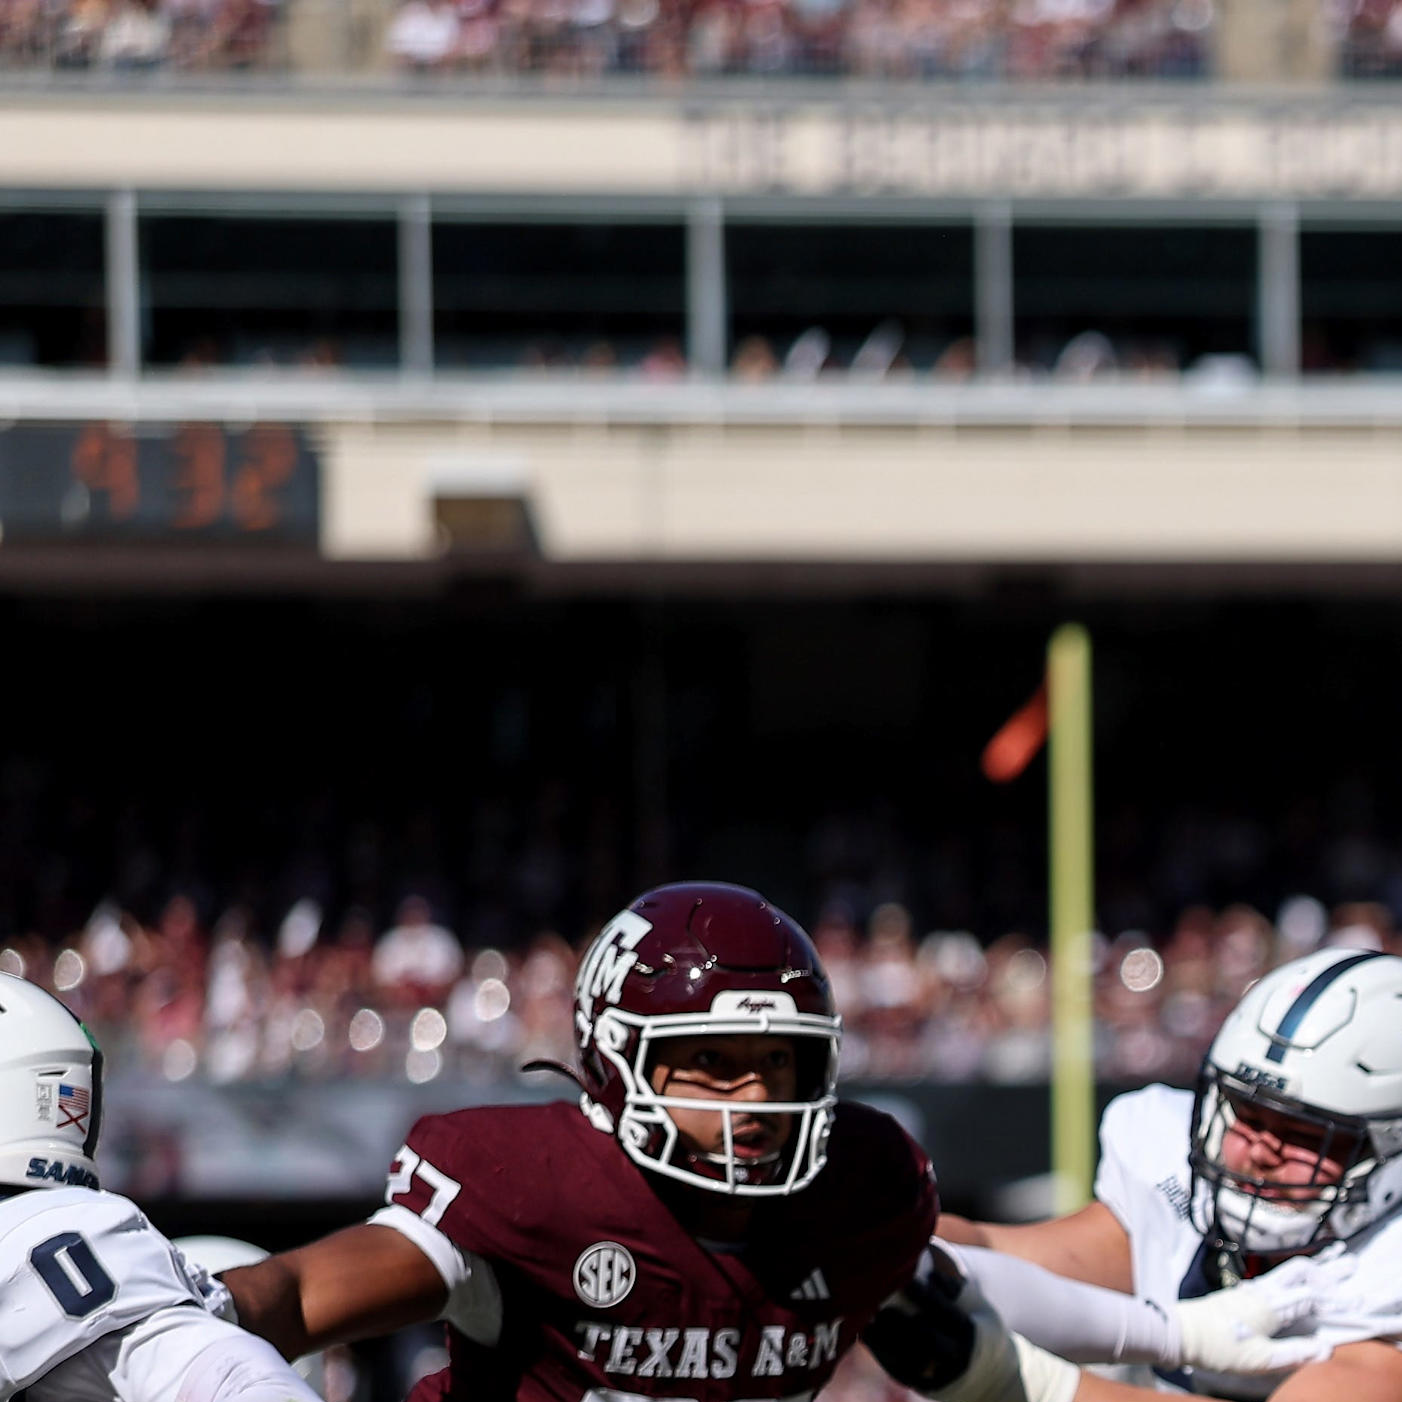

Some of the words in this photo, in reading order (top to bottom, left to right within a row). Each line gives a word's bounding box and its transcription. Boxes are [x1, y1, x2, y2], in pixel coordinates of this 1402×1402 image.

[384, 1143, 462, 1227] 27
[26, 1230, 119, 1322] 0
[580, 1248, 632, 1303] SEC
[575, 1320, 741, 1380] TEXAS
[751, 1316, 845, 1370] A&M
